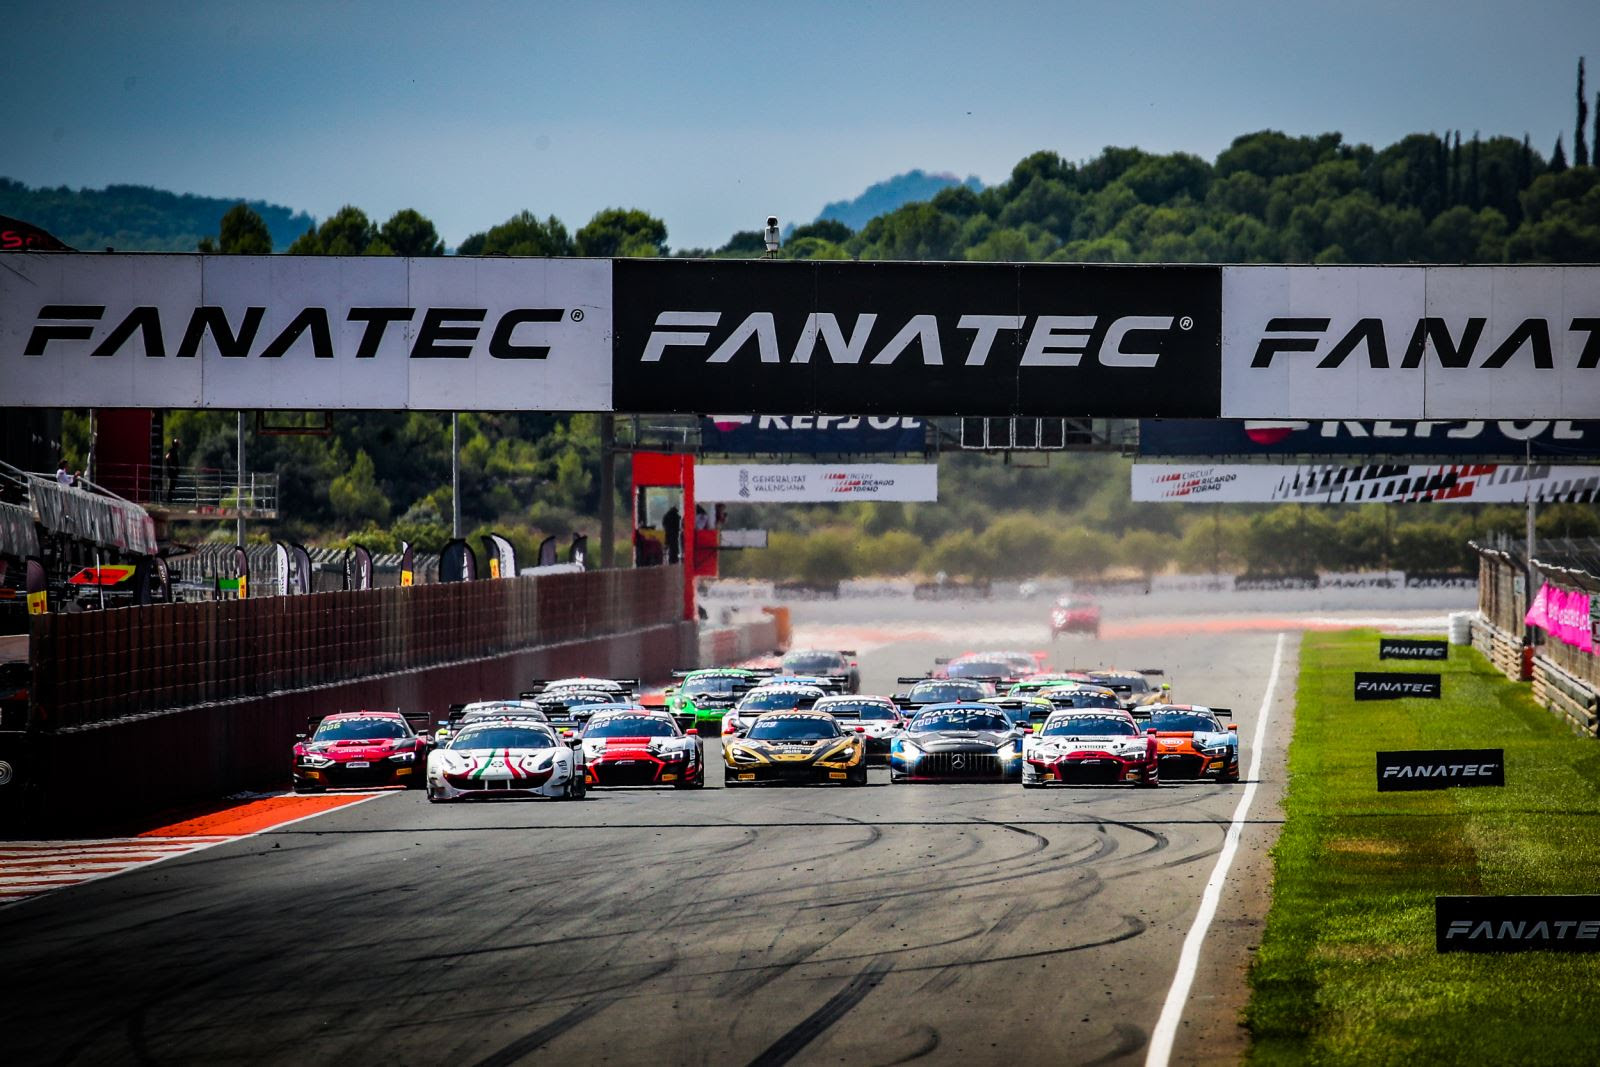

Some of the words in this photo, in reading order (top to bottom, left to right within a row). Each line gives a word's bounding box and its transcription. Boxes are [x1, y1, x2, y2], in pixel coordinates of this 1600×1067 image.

[24, 304, 565, 360] FANATEC
[640, 311, 1174, 367] FANATEC
[752, 475, 806, 483] GENERALITAT
[1182, 468, 1215, 480] CIRCUIT
[1201, 474, 1237, 484] RICARDO
[754, 484, 806, 492] VALENCIANA
[1191, 483, 1222, 494] TORMO
[1383, 646, 1444, 656] FANATEC
[1357, 682, 1434, 693] FANATEC
[758, 713, 833, 722] FANATEC
[922, 708, 994, 718] FANATEC
[1051, 713, 1129, 722] FANATEC
[1383, 763, 1497, 778] FANATEC
